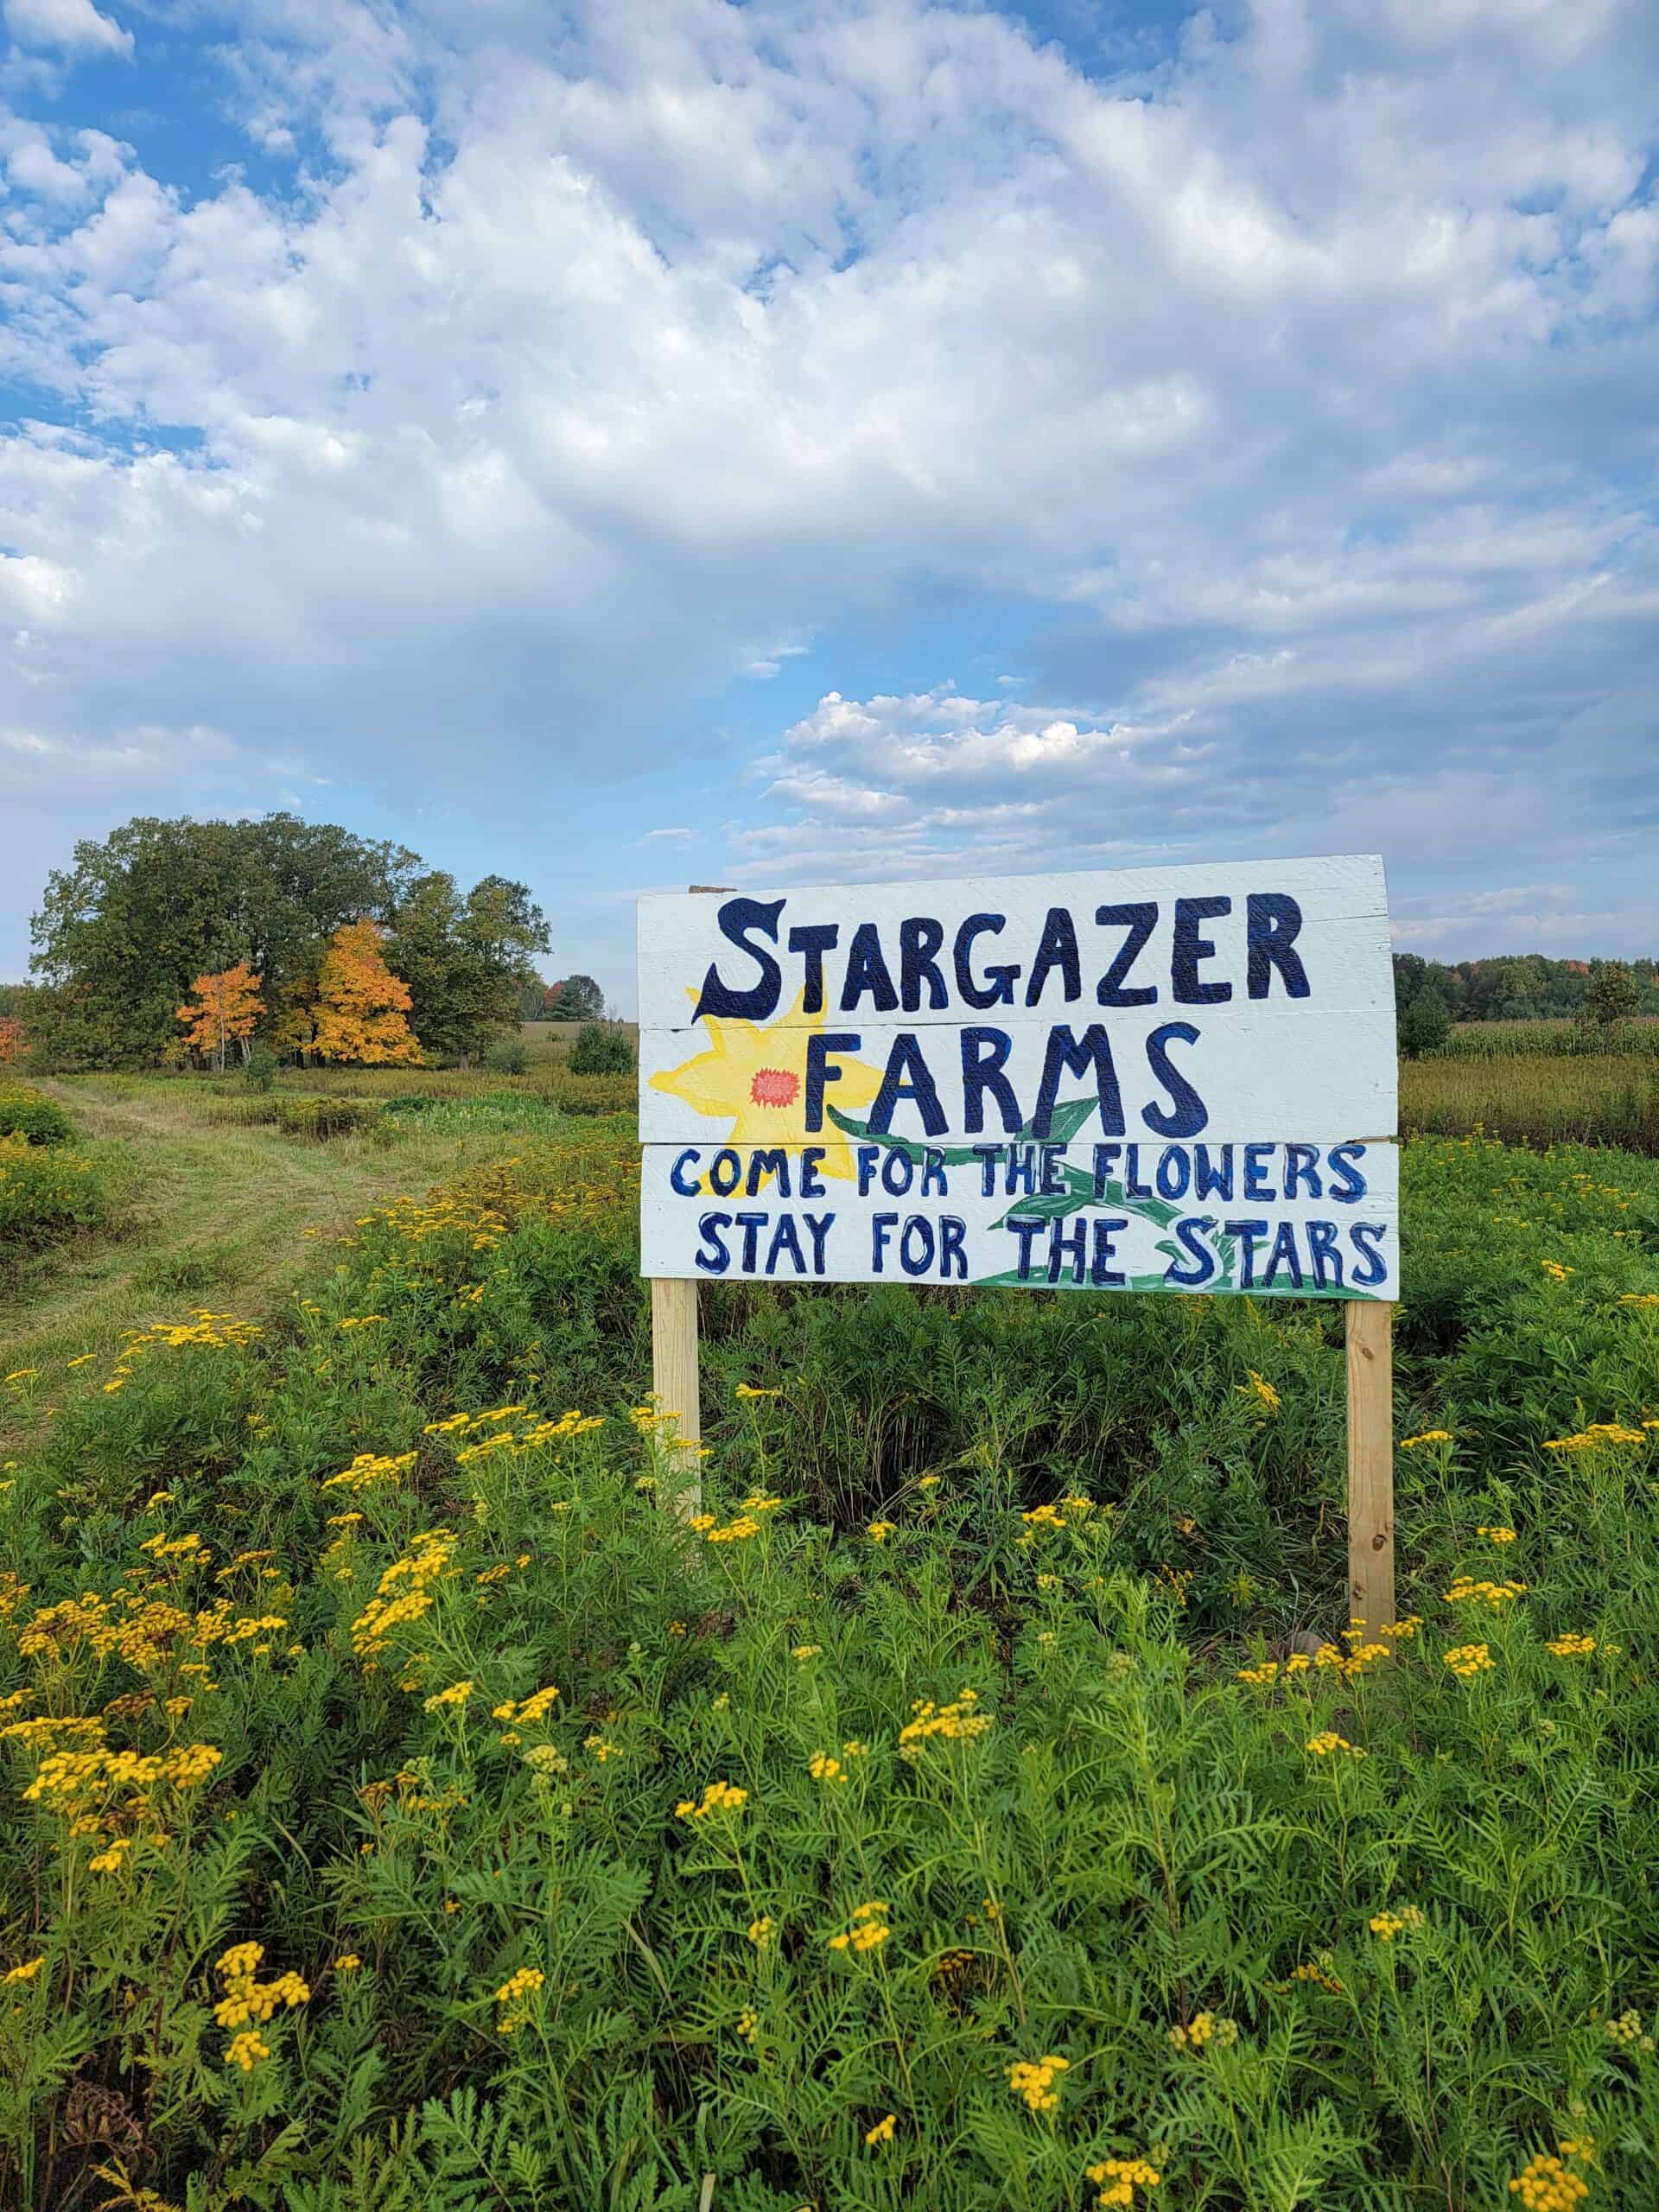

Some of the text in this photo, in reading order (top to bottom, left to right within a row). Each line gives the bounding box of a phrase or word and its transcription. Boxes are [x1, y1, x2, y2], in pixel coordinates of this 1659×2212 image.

[691, 893, 1311, 1029] STARGAZER
[805, 1021, 1209, 1141] FARMS
[670, 1141, 1367, 1205] COME FOR THE FLOWERS
[695, 1211, 1388, 1291] STAY FOR THE STARS
